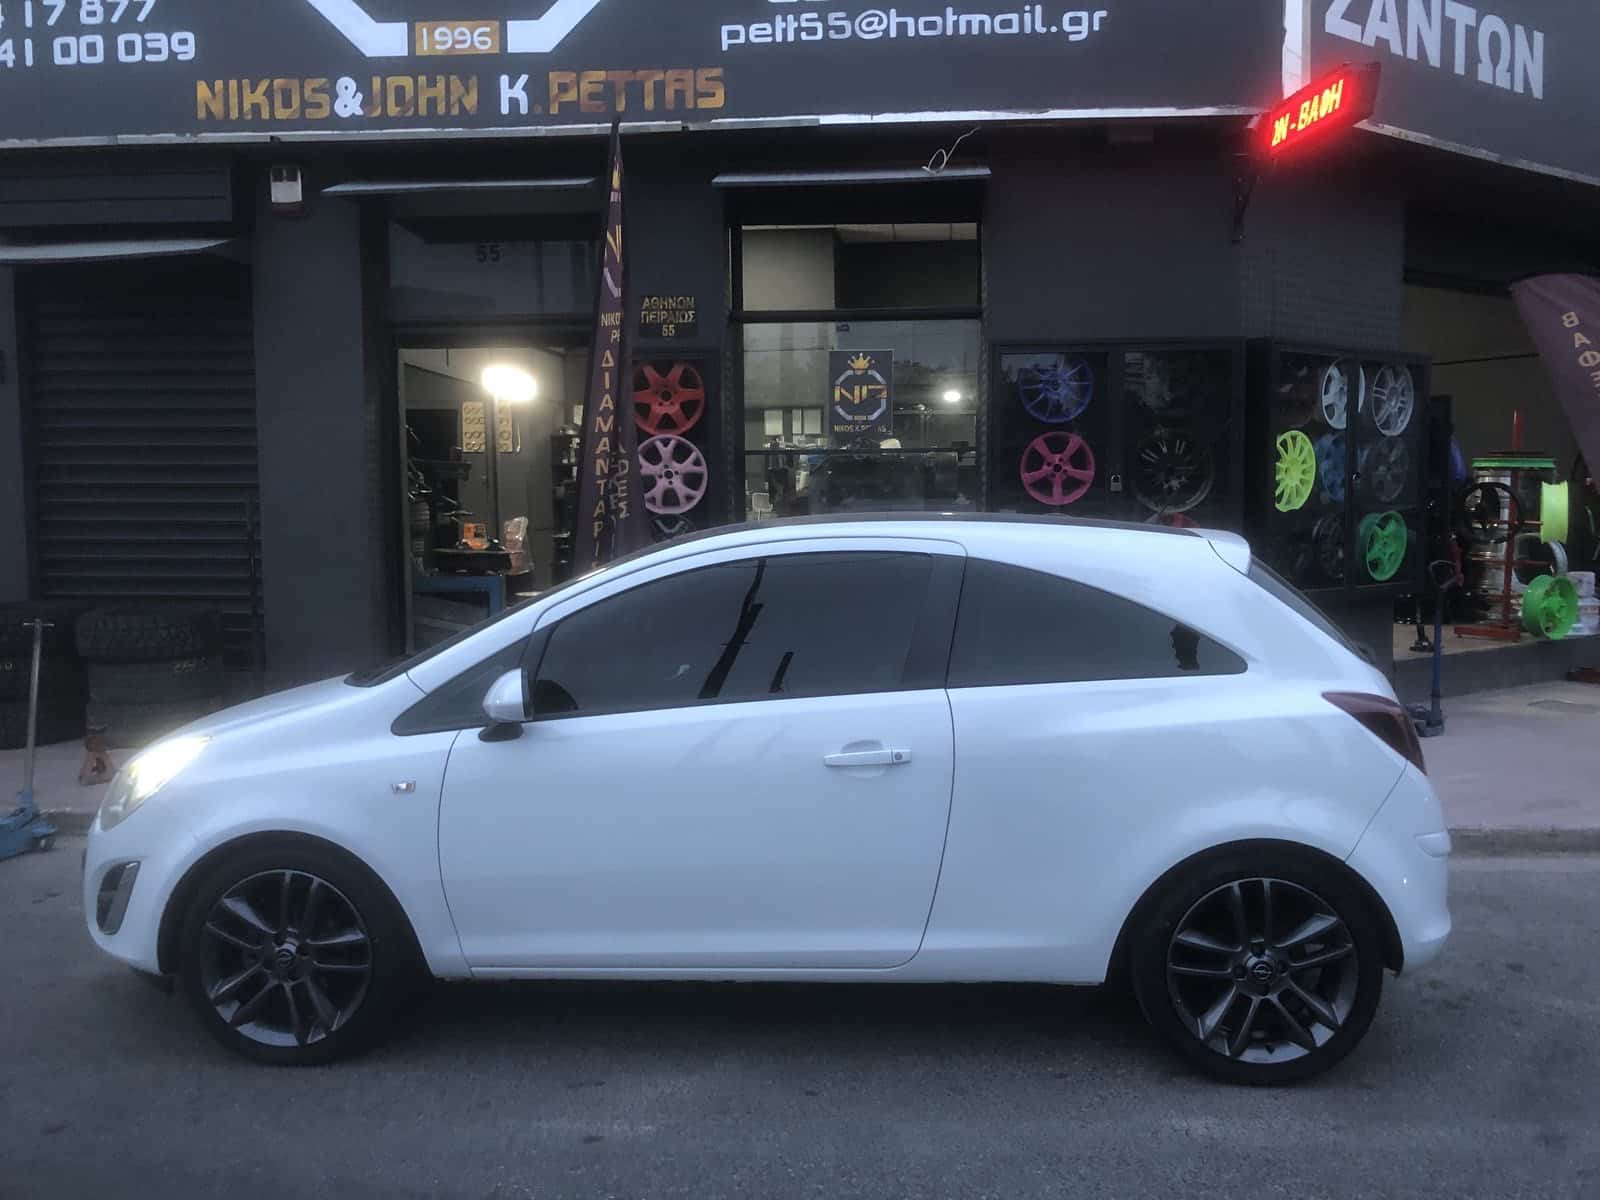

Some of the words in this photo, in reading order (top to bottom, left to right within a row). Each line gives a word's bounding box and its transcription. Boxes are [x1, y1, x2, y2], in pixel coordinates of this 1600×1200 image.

[421, 26, 492, 50] 1996
[721, 5, 1108, 51] pett55@hotmail.gr
[53, 35, 104, 65] 00
[117, 31, 195, 63] 039
